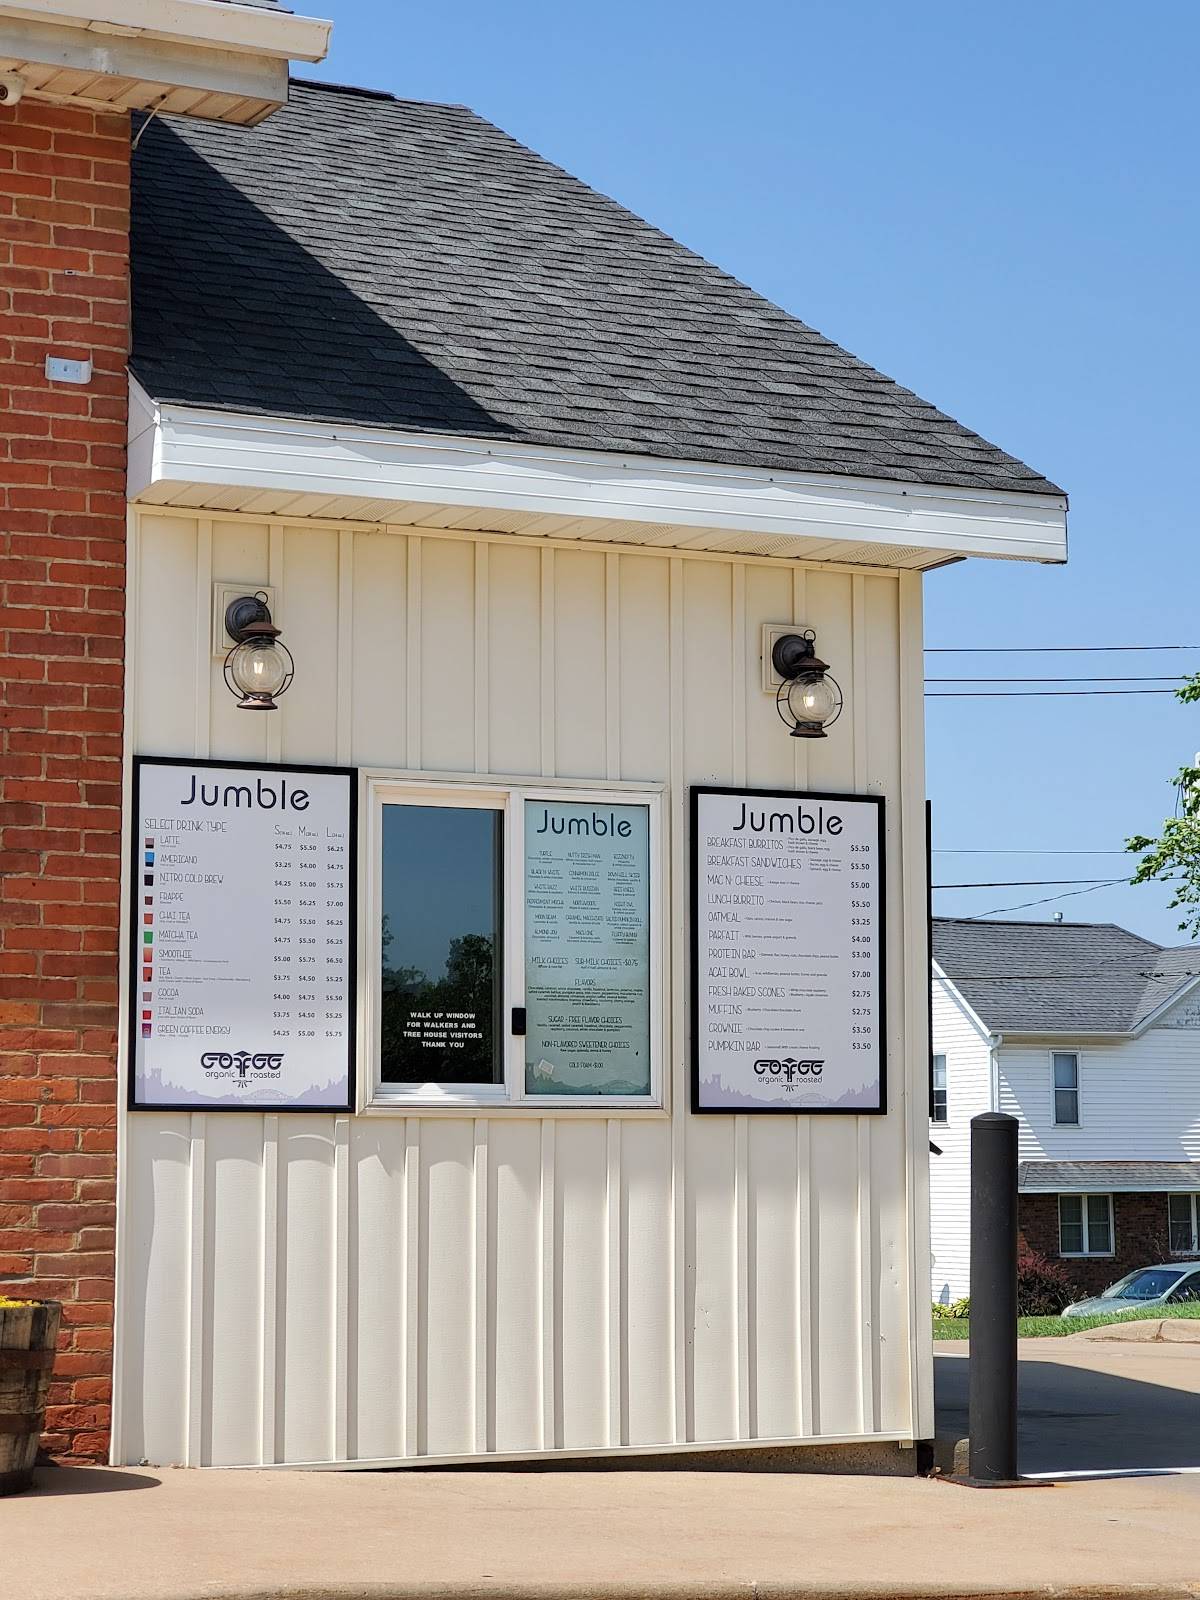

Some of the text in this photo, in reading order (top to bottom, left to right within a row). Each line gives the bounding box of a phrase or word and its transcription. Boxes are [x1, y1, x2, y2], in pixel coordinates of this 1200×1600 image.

[181, 775, 310, 810] Jumble
[537, 809, 631, 837] Jumble
[733, 803, 843, 835] Jumble
[144, 819, 227, 833] SELECT DRINK TYPE
[160, 836, 180, 844] LATTE
[707, 837, 746, 848] BREAKFAST
[749, 839, 783, 850] BURRITOS
[160, 855, 197, 864] AMERICANO
[707, 856, 750, 867] BREAKFAST
[752, 857, 801, 869] SANDWICHES
[160, 872, 224, 884] NITRO COLD BREW
[707, 875, 723, 885] MAC
[735, 876, 764, 886] CHEESE
[160, 892, 184, 902] FRAPPE
[708, 894, 732, 904] LUNCH
[733, 895, 764, 905] BURRITO
[159, 912, 190, 920] CHAI TEA
[708, 912, 740, 922] OATMEAL
[159, 930, 198, 940] MATCHA TEA
[708, 930, 740, 940] PARFAIT
[159, 950, 192, 958] SMOOTHIE
[708, 949, 756, 959] PROTEIN BAR
[159, 967, 171, 976] TEA
[708, 967, 749, 978] ACAI BOWL
[158, 988, 179, 997] COCOA
[708, 986, 785, 998] FRESH BAKED SCONES
[158, 1007, 204, 1016] ITALIAN SODA
[708, 1005, 742, 1015] MUFFINS
[158, 1025, 230, 1035] GREEN COFFEE ENERGY
[708, 1023, 742, 1033] CROWNIE
[708, 1041, 760, 1051] PUMPKIN BAR
[205, 1071, 280, 1080] organic roasted
[758, 1076, 783, 1084] organic
